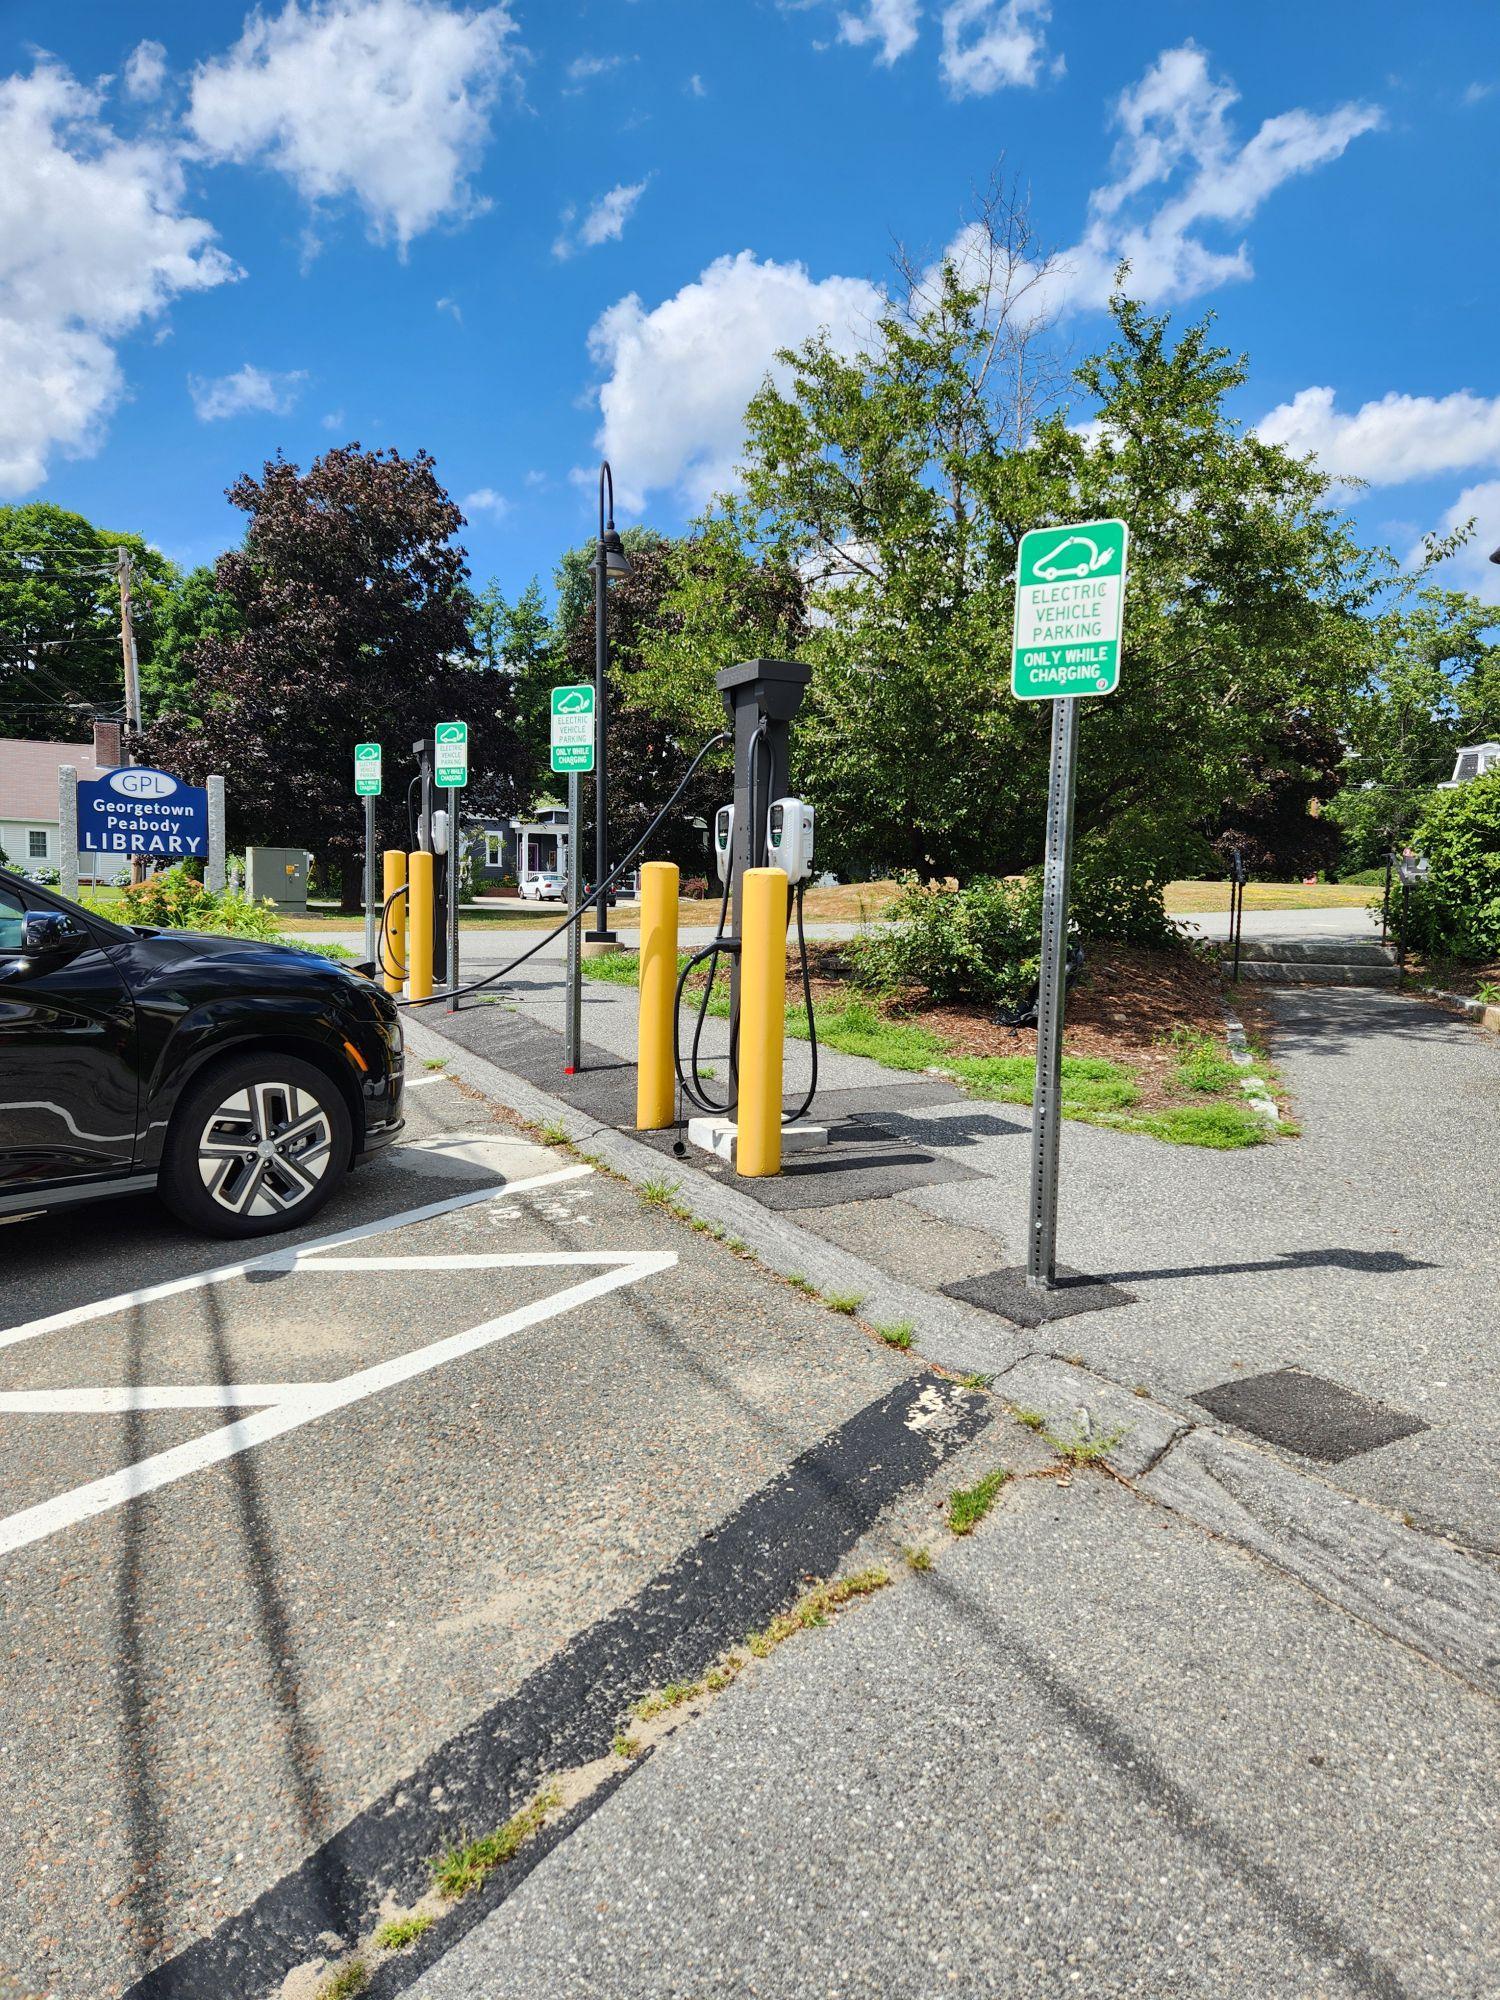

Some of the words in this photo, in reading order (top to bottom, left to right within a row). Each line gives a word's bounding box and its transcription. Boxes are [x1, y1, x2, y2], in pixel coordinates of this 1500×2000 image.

[1032, 582, 1107, 605] ELECTRIC
[1036, 602, 1101, 622] VEHICLE
[1033, 621, 1102, 642] PARKING
[1023, 650, 1062, 667] ONLY
[1065, 646, 1108, 664] WHILE
[1029, 664, 1100, 683] CHARGING
[122, 775, 165, 793] GPL
[93, 799, 194, 817] Georgetown
[107, 816, 180, 834] Peabody
[86, 832, 201, 853] LIBRARY
